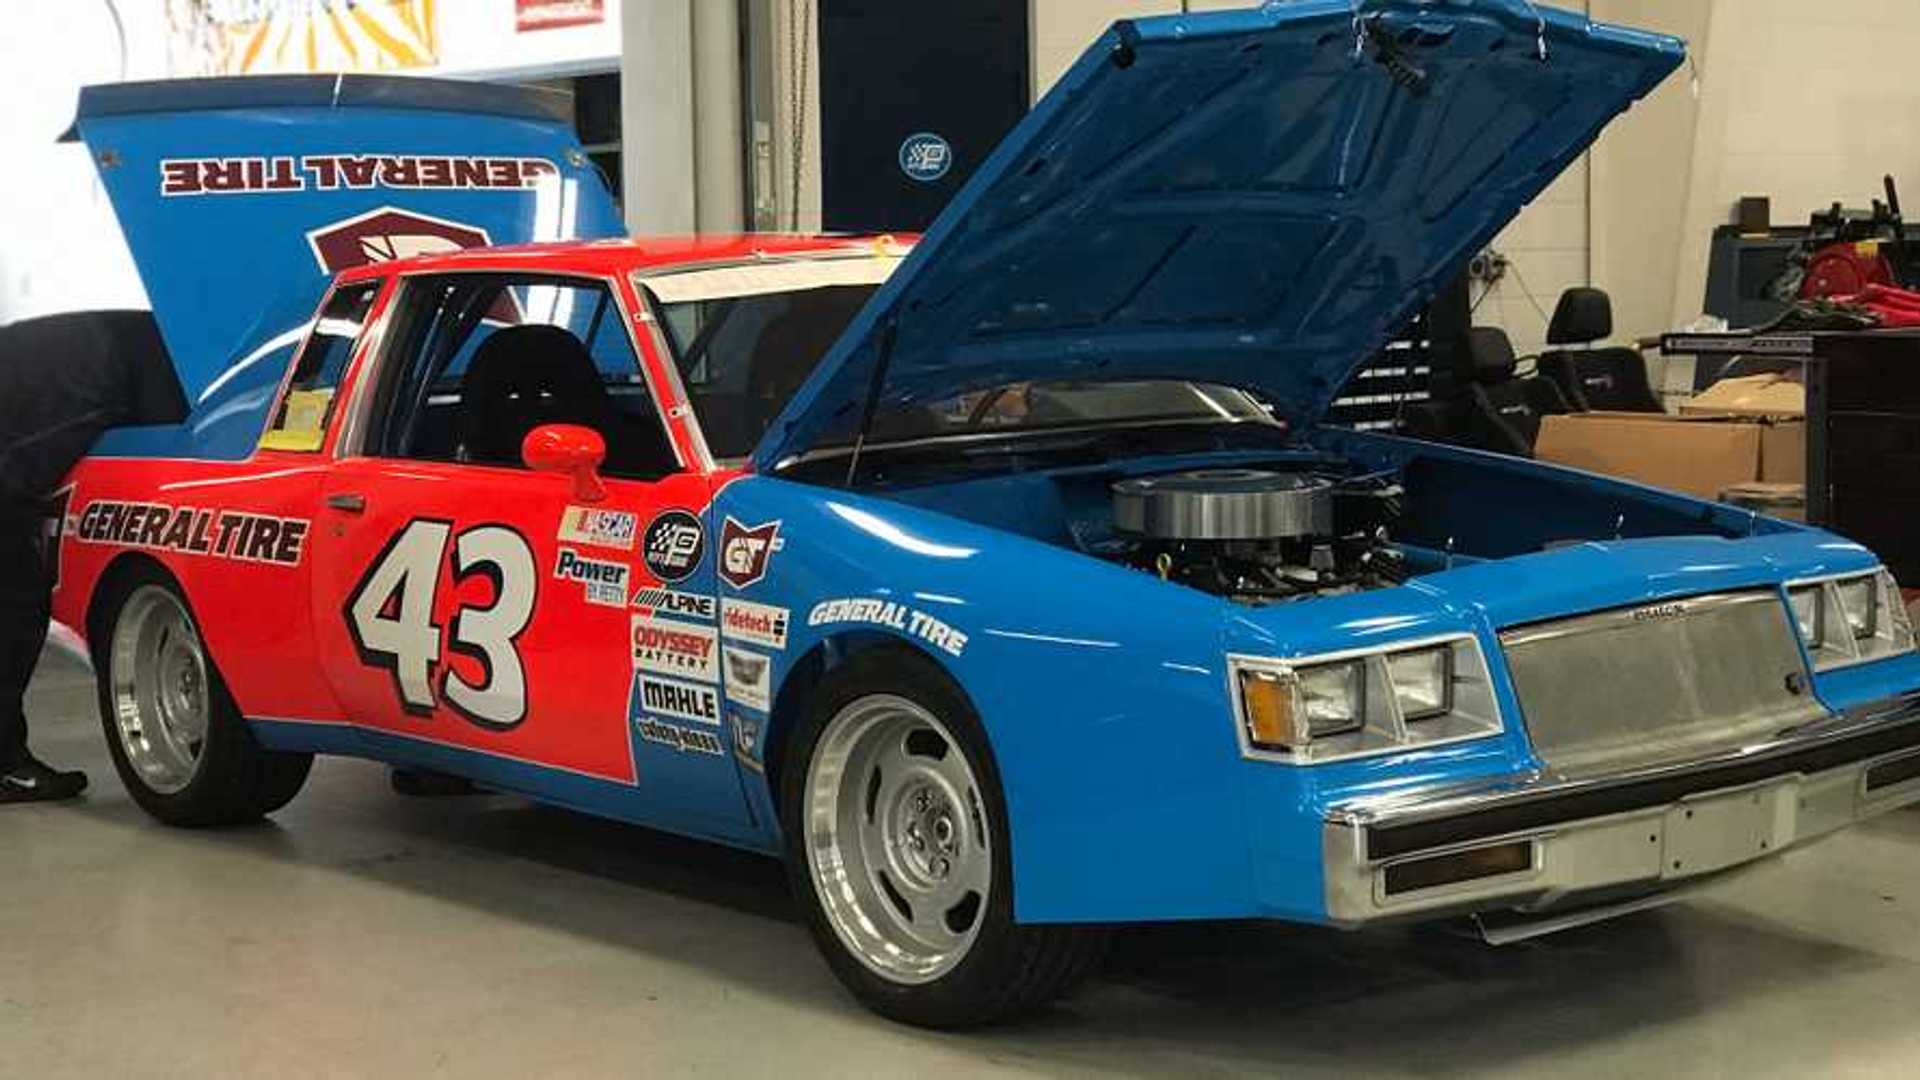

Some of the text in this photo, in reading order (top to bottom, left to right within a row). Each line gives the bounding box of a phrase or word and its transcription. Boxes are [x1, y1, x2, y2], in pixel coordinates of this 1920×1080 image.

[161, 155, 559, 195] GENERAL TIRE
[79, 500, 311, 567] GENERAL TIRE
[556, 550, 627, 585] Power
[659, 590, 713, 615] ALPINE
[343, 517, 539, 732] 43
[634, 625, 713, 658] ODYSSEY
[808, 598, 969, 658] GENERAL TIRE
[634, 648, 709, 671] BATTERY
[643, 681, 717, 718] MAHLE
